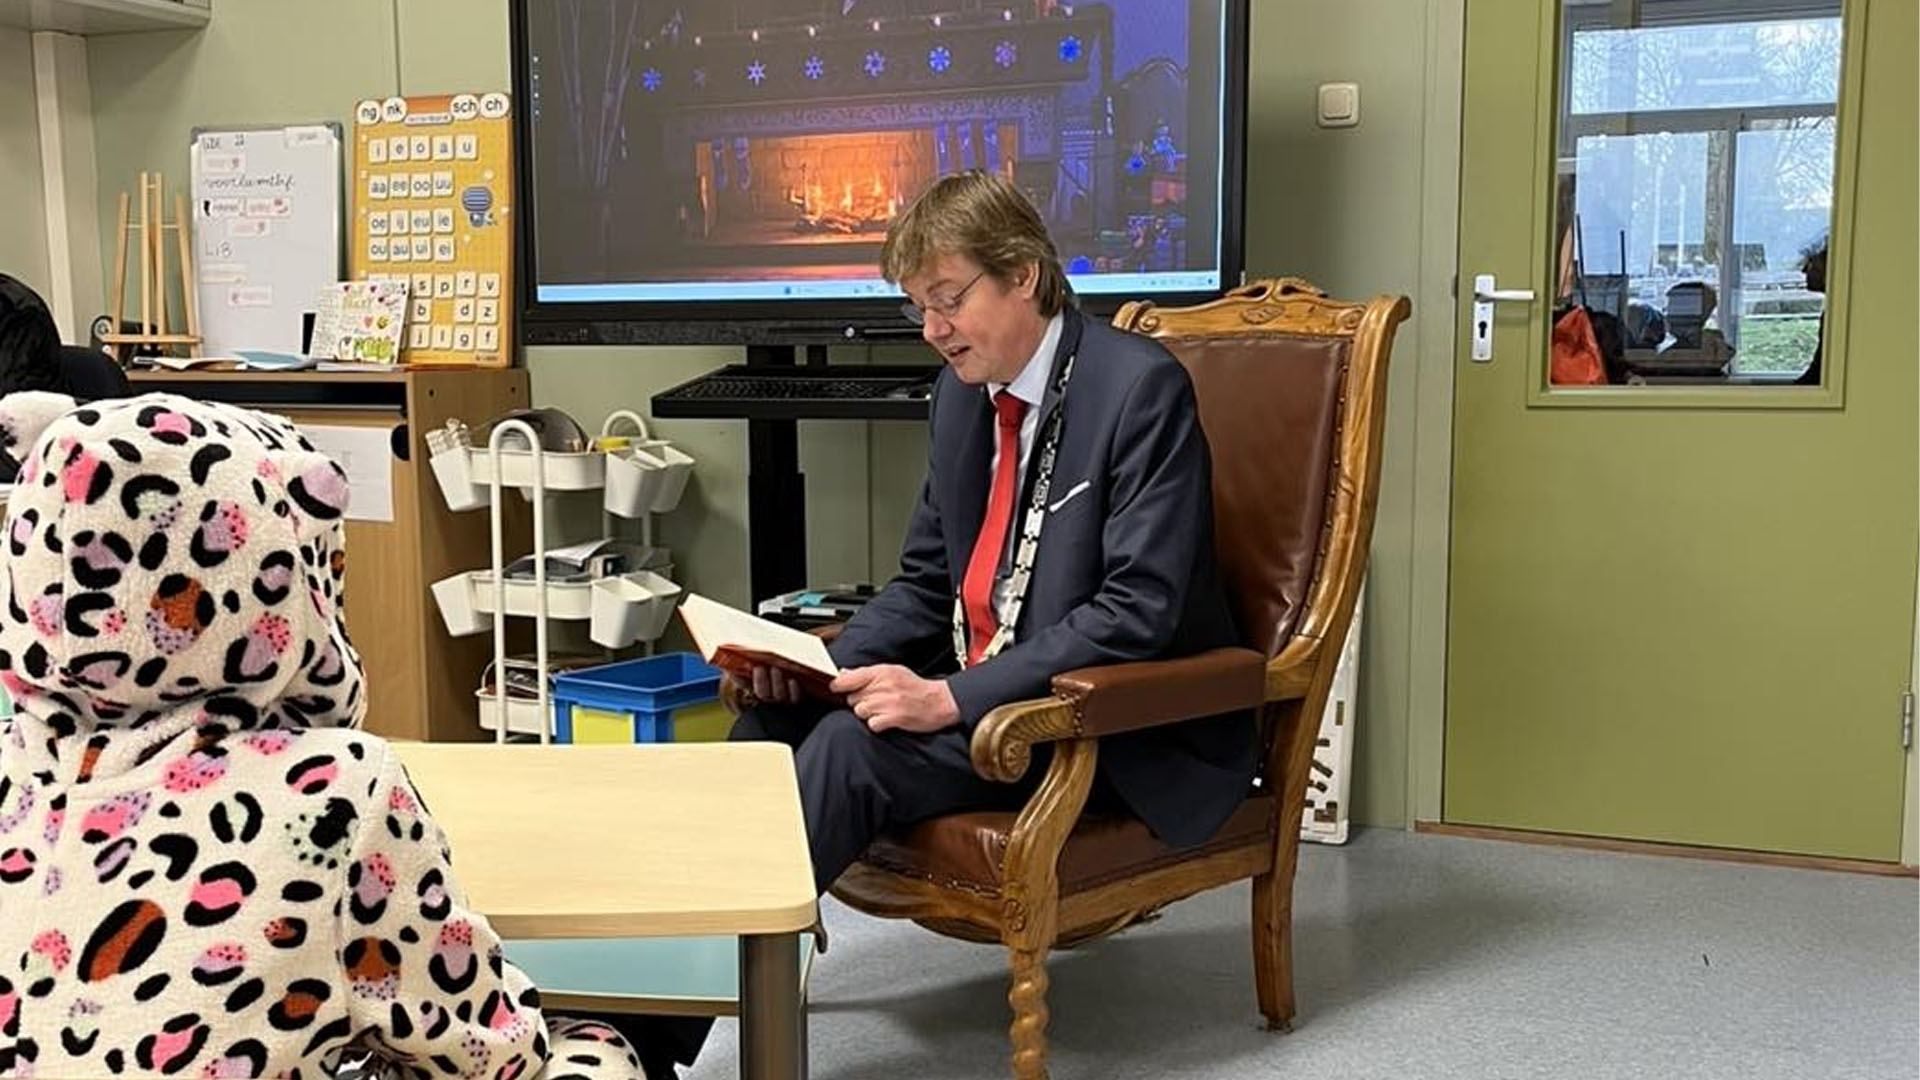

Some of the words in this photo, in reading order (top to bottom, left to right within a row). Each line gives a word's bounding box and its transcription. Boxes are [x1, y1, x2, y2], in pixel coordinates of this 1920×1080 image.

[361, 107, 377, 120] ng
[386, 104, 402, 115] nk
[453, 100, 476, 112] sch
[485, 99, 502, 110] ch
[372, 182, 386, 194] aa
[393, 181, 406, 191] ee
[414, 181, 430, 191] oo
[435, 180, 451, 190] uu
[372, 218, 386, 229] oe
[396, 216, 404, 230] ij
[414, 217, 429, 227] eu
[438, 216, 450, 226] ie
[371, 244, 387, 255] ou
[393, 245, 408, 256] au
[416, 244, 428, 254] ui
[439, 245, 450, 256] ei
